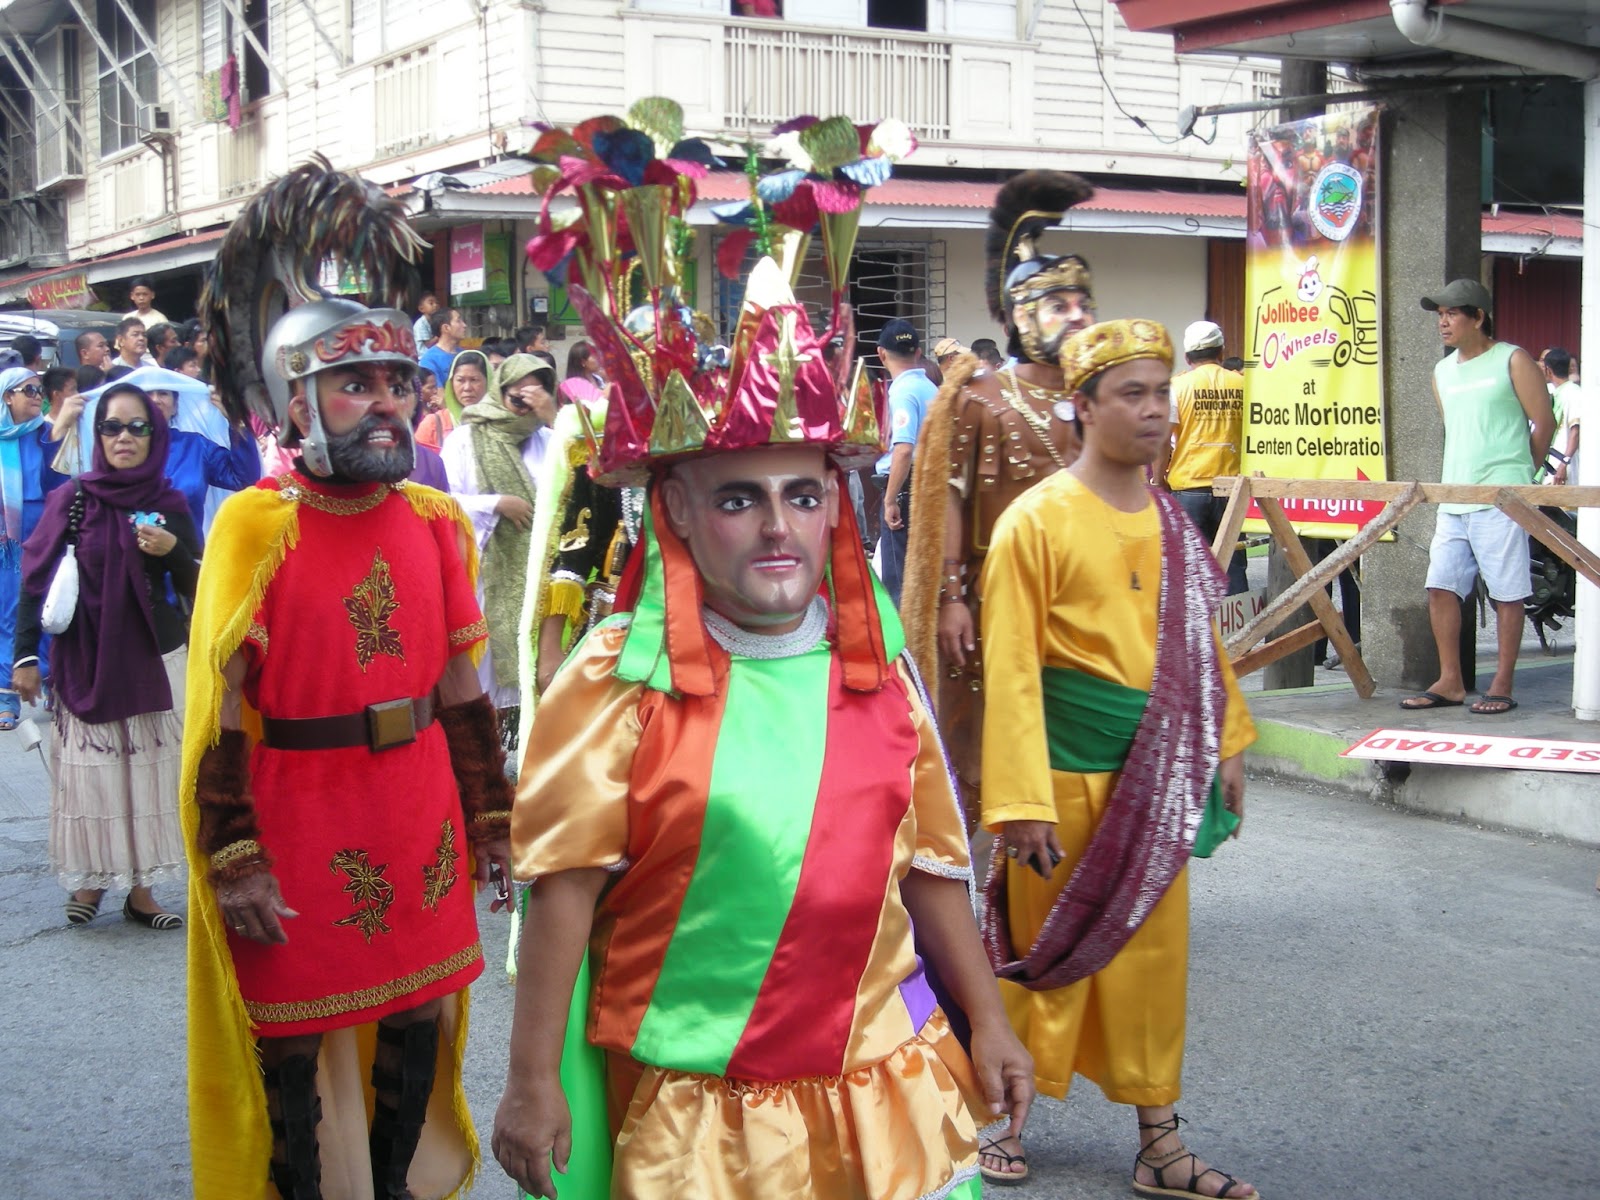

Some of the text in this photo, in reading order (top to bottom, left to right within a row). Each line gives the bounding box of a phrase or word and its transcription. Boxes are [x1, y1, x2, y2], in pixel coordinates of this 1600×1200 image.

[1262, 299, 1319, 324] Jollibee
[1282, 328, 1337, 361] Wheels
[1303, 379, 1316, 395] at
[1194, 400, 1230, 411] CIVICOM
[1249, 402, 1290, 426] Boac
[1246, 436, 1383, 456] Lenten Celebratio
[1220, 600, 1245, 637] HIS
[1364, 737, 1493, 756] ROAD
